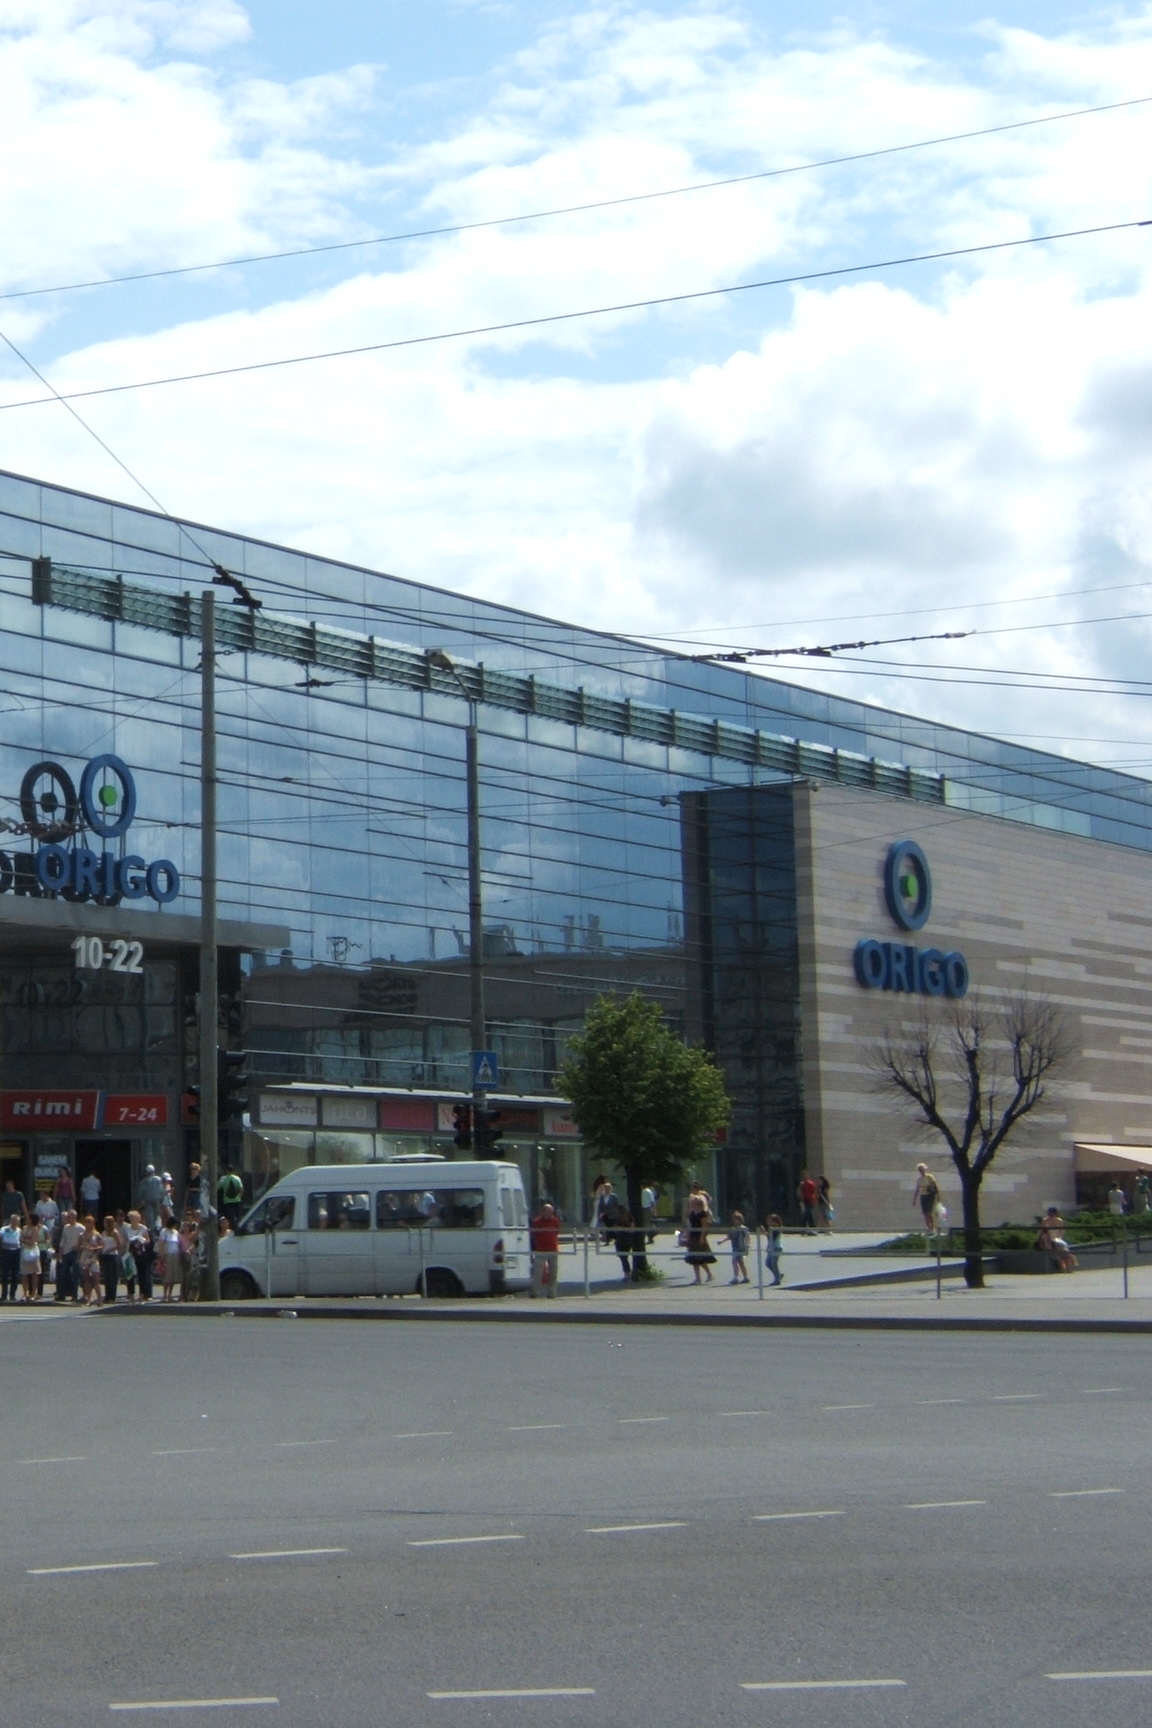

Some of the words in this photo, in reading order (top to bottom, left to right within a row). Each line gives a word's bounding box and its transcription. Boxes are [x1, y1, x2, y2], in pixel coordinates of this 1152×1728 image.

[36, 844, 180, 903] ORIGO
[71, 936, 144, 973] 10-22
[853, 939, 969, 998] ORIGO
[119, 1107, 158, 1122] 7-24
